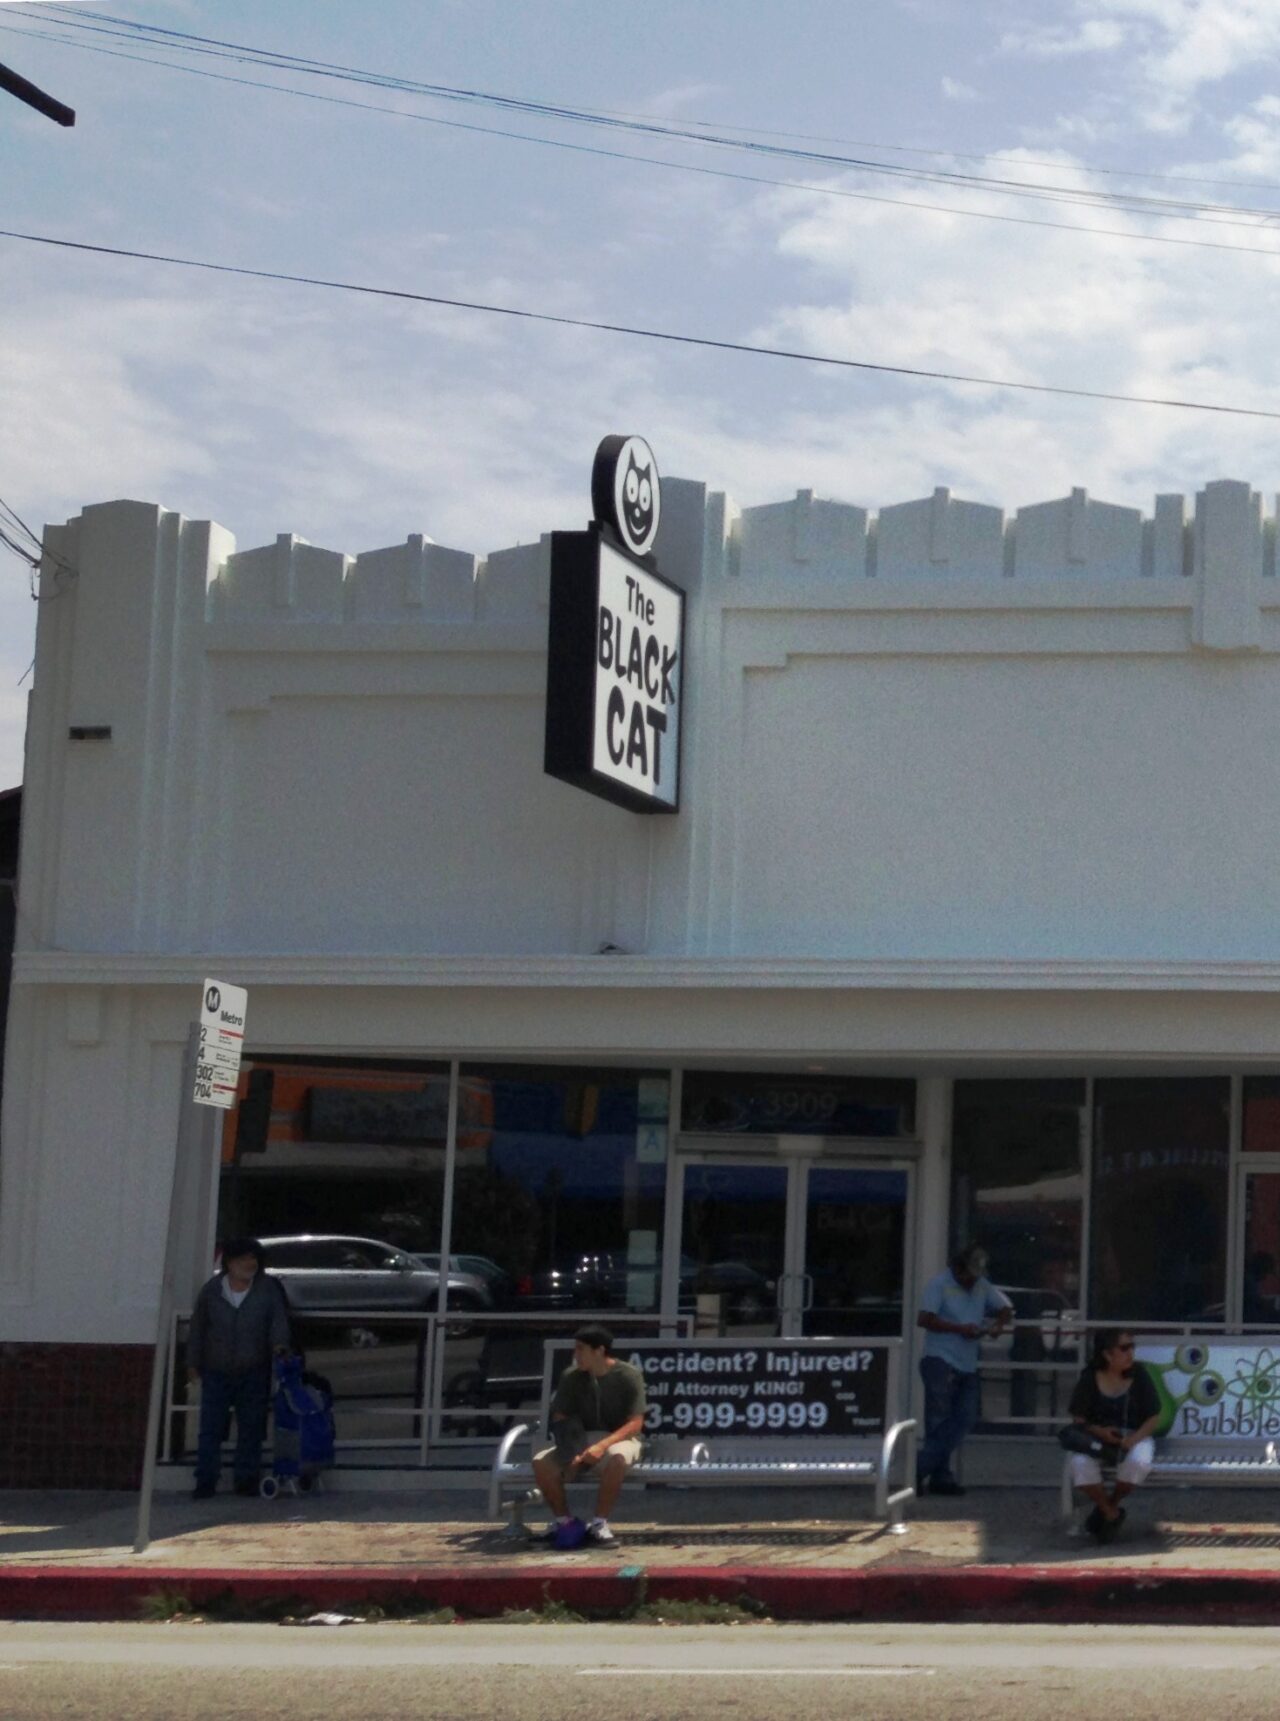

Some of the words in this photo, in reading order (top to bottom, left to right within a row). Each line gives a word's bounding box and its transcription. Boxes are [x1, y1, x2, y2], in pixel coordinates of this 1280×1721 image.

[625, 575, 655, 627] The
[598, 605, 677, 705] BLACK
[606, 685, 667, 785] CAT
[220, 1010, 243, 1026] Metro
[200, 1027, 207, 1042] 2
[198, 1046, 205, 1060] 4
[196, 1065, 214, 1081] 302
[194, 1082, 212, 1099] 704
[765, 1090, 837, 1118] 3909
[629, 1351, 758, 1373] Accident?
[766, 1350, 873, 1376] Injured?
[644, 1382, 669, 1396] all
[673, 1382, 749, 1398] Attorney
[754, 1381, 805, 1395] KING!
[644, 1402, 828, 1429] 3-999-9999
